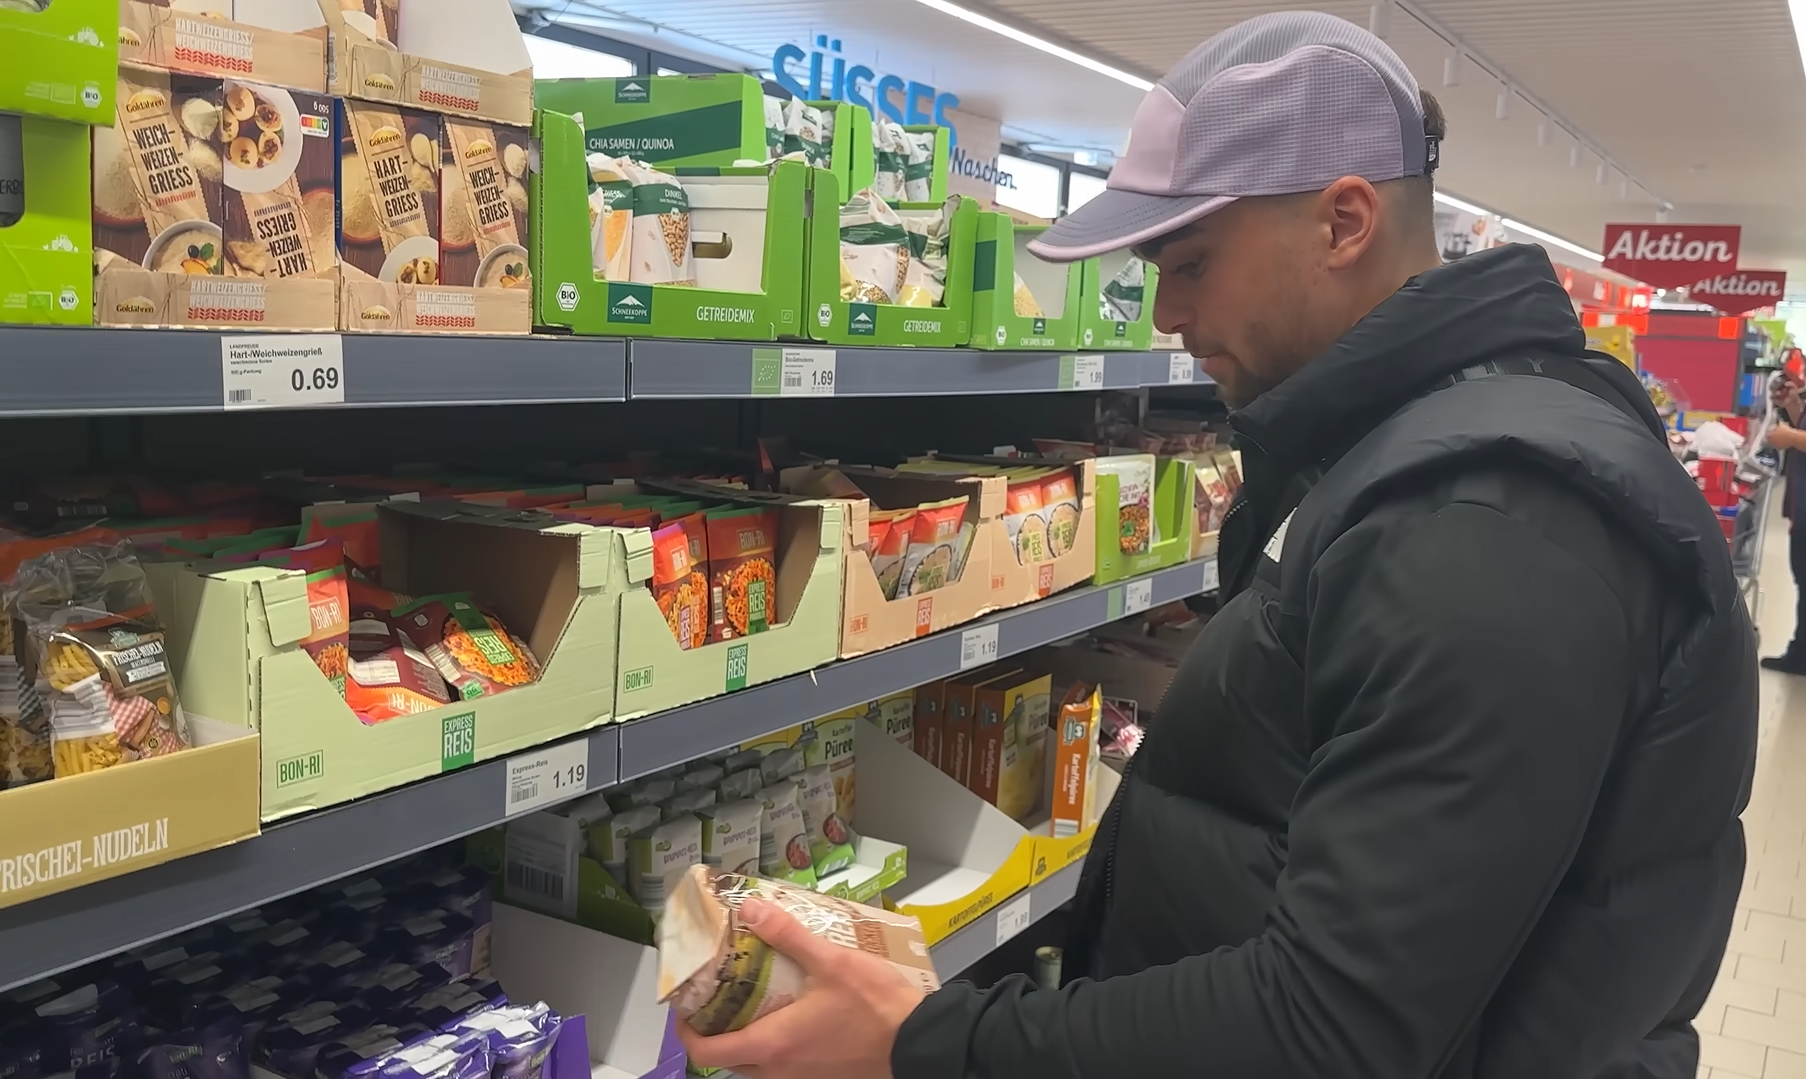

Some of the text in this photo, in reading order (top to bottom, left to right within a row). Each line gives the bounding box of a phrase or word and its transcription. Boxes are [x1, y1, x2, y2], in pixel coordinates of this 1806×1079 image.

[132, 123, 176, 148] WEICH-
[589, 137, 608, 150] CHIA
[609, 138, 635, 149] SAMEN
[641, 138, 675, 150] QUINOA
[139, 146, 184, 171] WEIZEN-
[373, 160, 408, 179] HART-
[952, 146, 1017, 190] Naschen
[148, 166, 194, 196] GRIESS
[379, 175, 412, 197] WEIZEN-
[469, 166, 500, 189] WEICH-
[384, 192, 419, 218] GRIESS
[473, 189, 504, 206] WEIZEN-
[664, 188, 683, 200] DINKEL
[478, 201, 509, 226] GRIESS
[256, 211, 297, 241] GRIESS
[265, 234, 303, 259] WEIZEN-
[1607, 229, 1733, 263] Aktion
[269, 252, 308, 278] HART-
[1692, 274, 1781, 297] Aktion
[116, 303, 155, 315] Goldähren
[611, 306, 648, 317] SCHNEEKOPPE
[696, 305, 756, 324] GETREIDEMIX
[903, 319, 942, 334] GETREIDEMIX
[230, 347, 323, 359] Hart-/Weichweizengrieß
[291, 367, 339, 391] 0.69
[812, 370, 834, 386] 1.69
[739, 529, 765, 549] BON-RI
[749, 592, 766, 613] REIS
[311, 602, 342, 630] BON-RI
[474, 634, 508, 655] REIS
[728, 645, 747, 659] EXPRESS
[981, 640, 997, 656] 1.19
[625, 669, 651, 689] BON-RI
[727, 657, 747, 680] REIS
[392, 693, 434, 715] ON-RI
[443, 716, 473, 733] EXPRESS
[887, 715, 911, 735] Püree
[443, 729, 473, 759] REIS
[825, 738, 853, 760] Püree
[280, 755, 321, 783] BON-RI
[512, 760, 548, 775] Express-Reis
[553, 764, 585, 789] 1.19
[1068, 753, 1081, 805] Kartoffelpüree
[0, 817, 169, 893] RISCHEI-NUDELN
